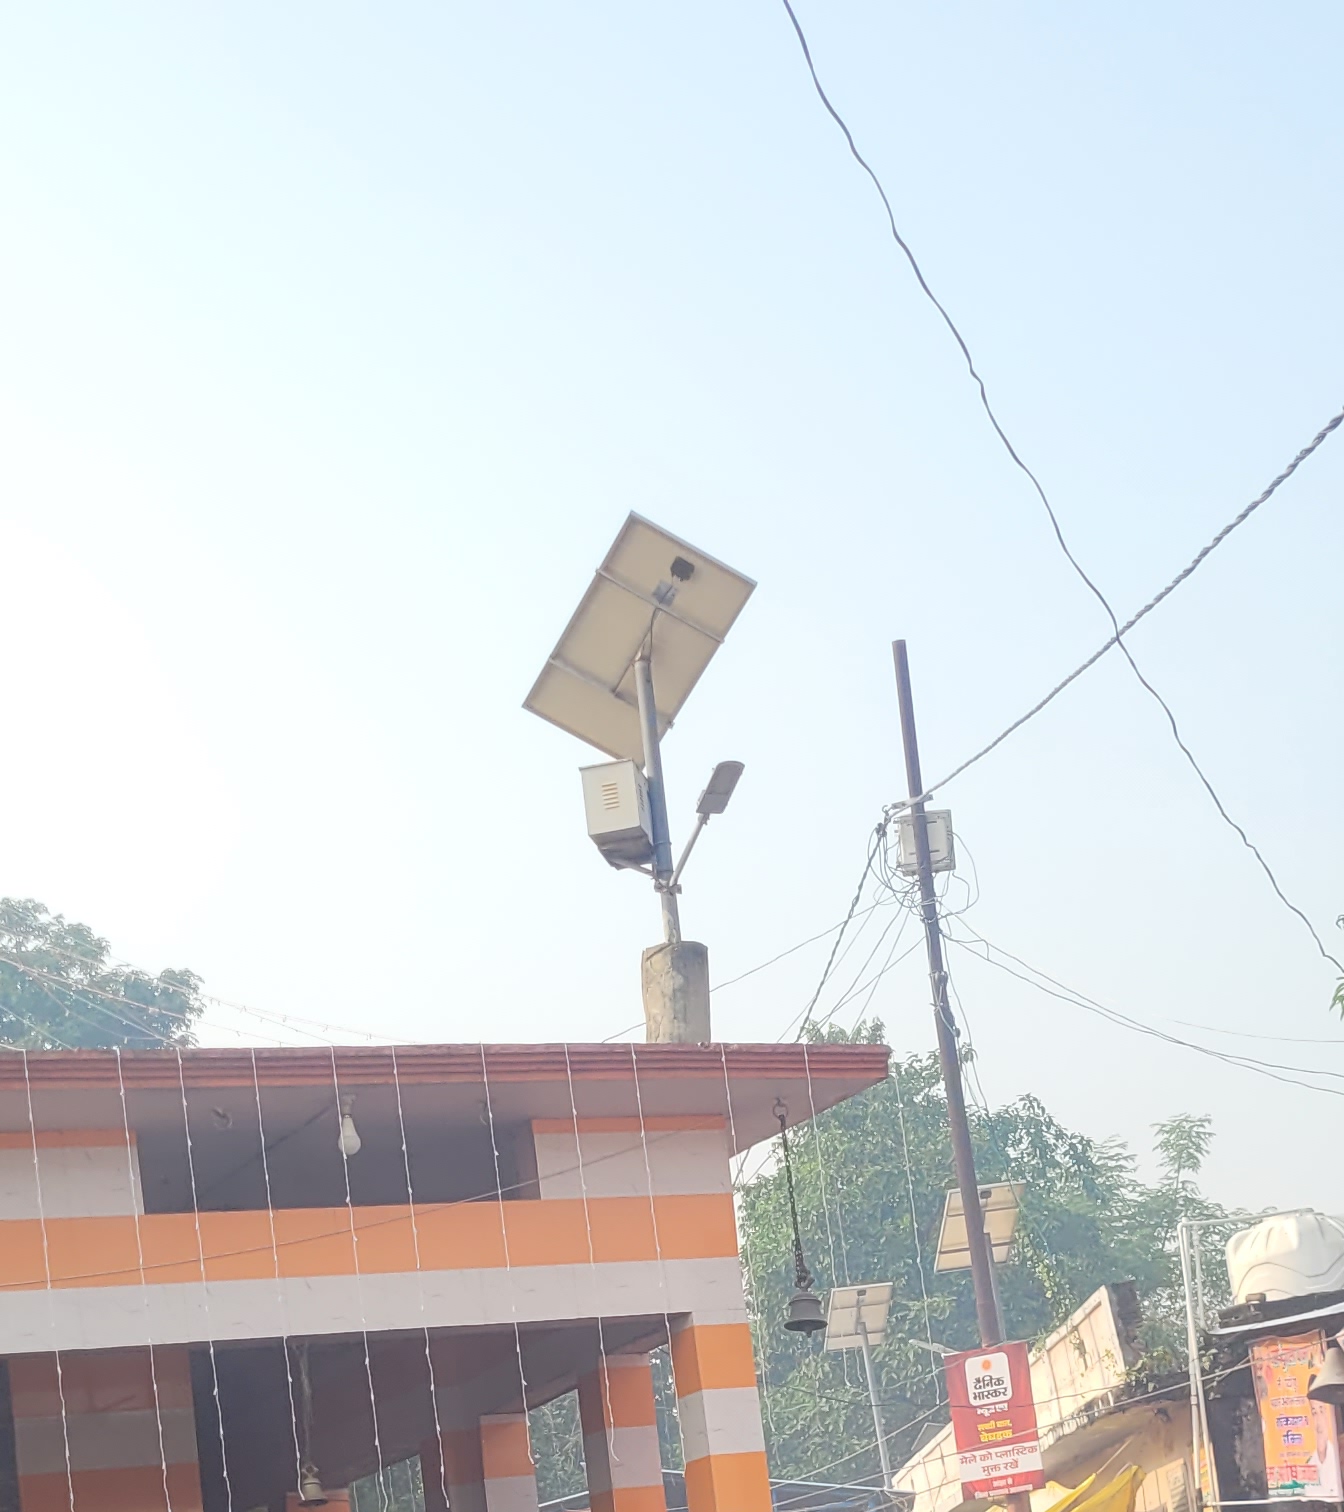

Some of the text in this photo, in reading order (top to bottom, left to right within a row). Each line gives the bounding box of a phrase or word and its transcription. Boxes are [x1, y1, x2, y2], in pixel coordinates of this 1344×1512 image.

[973, 1374, 1005, 1391] दैनिक
[972, 1387, 1008, 1401] भास्कर
[959, 1444, 1038, 1466] मेले को प्लास्टिक
